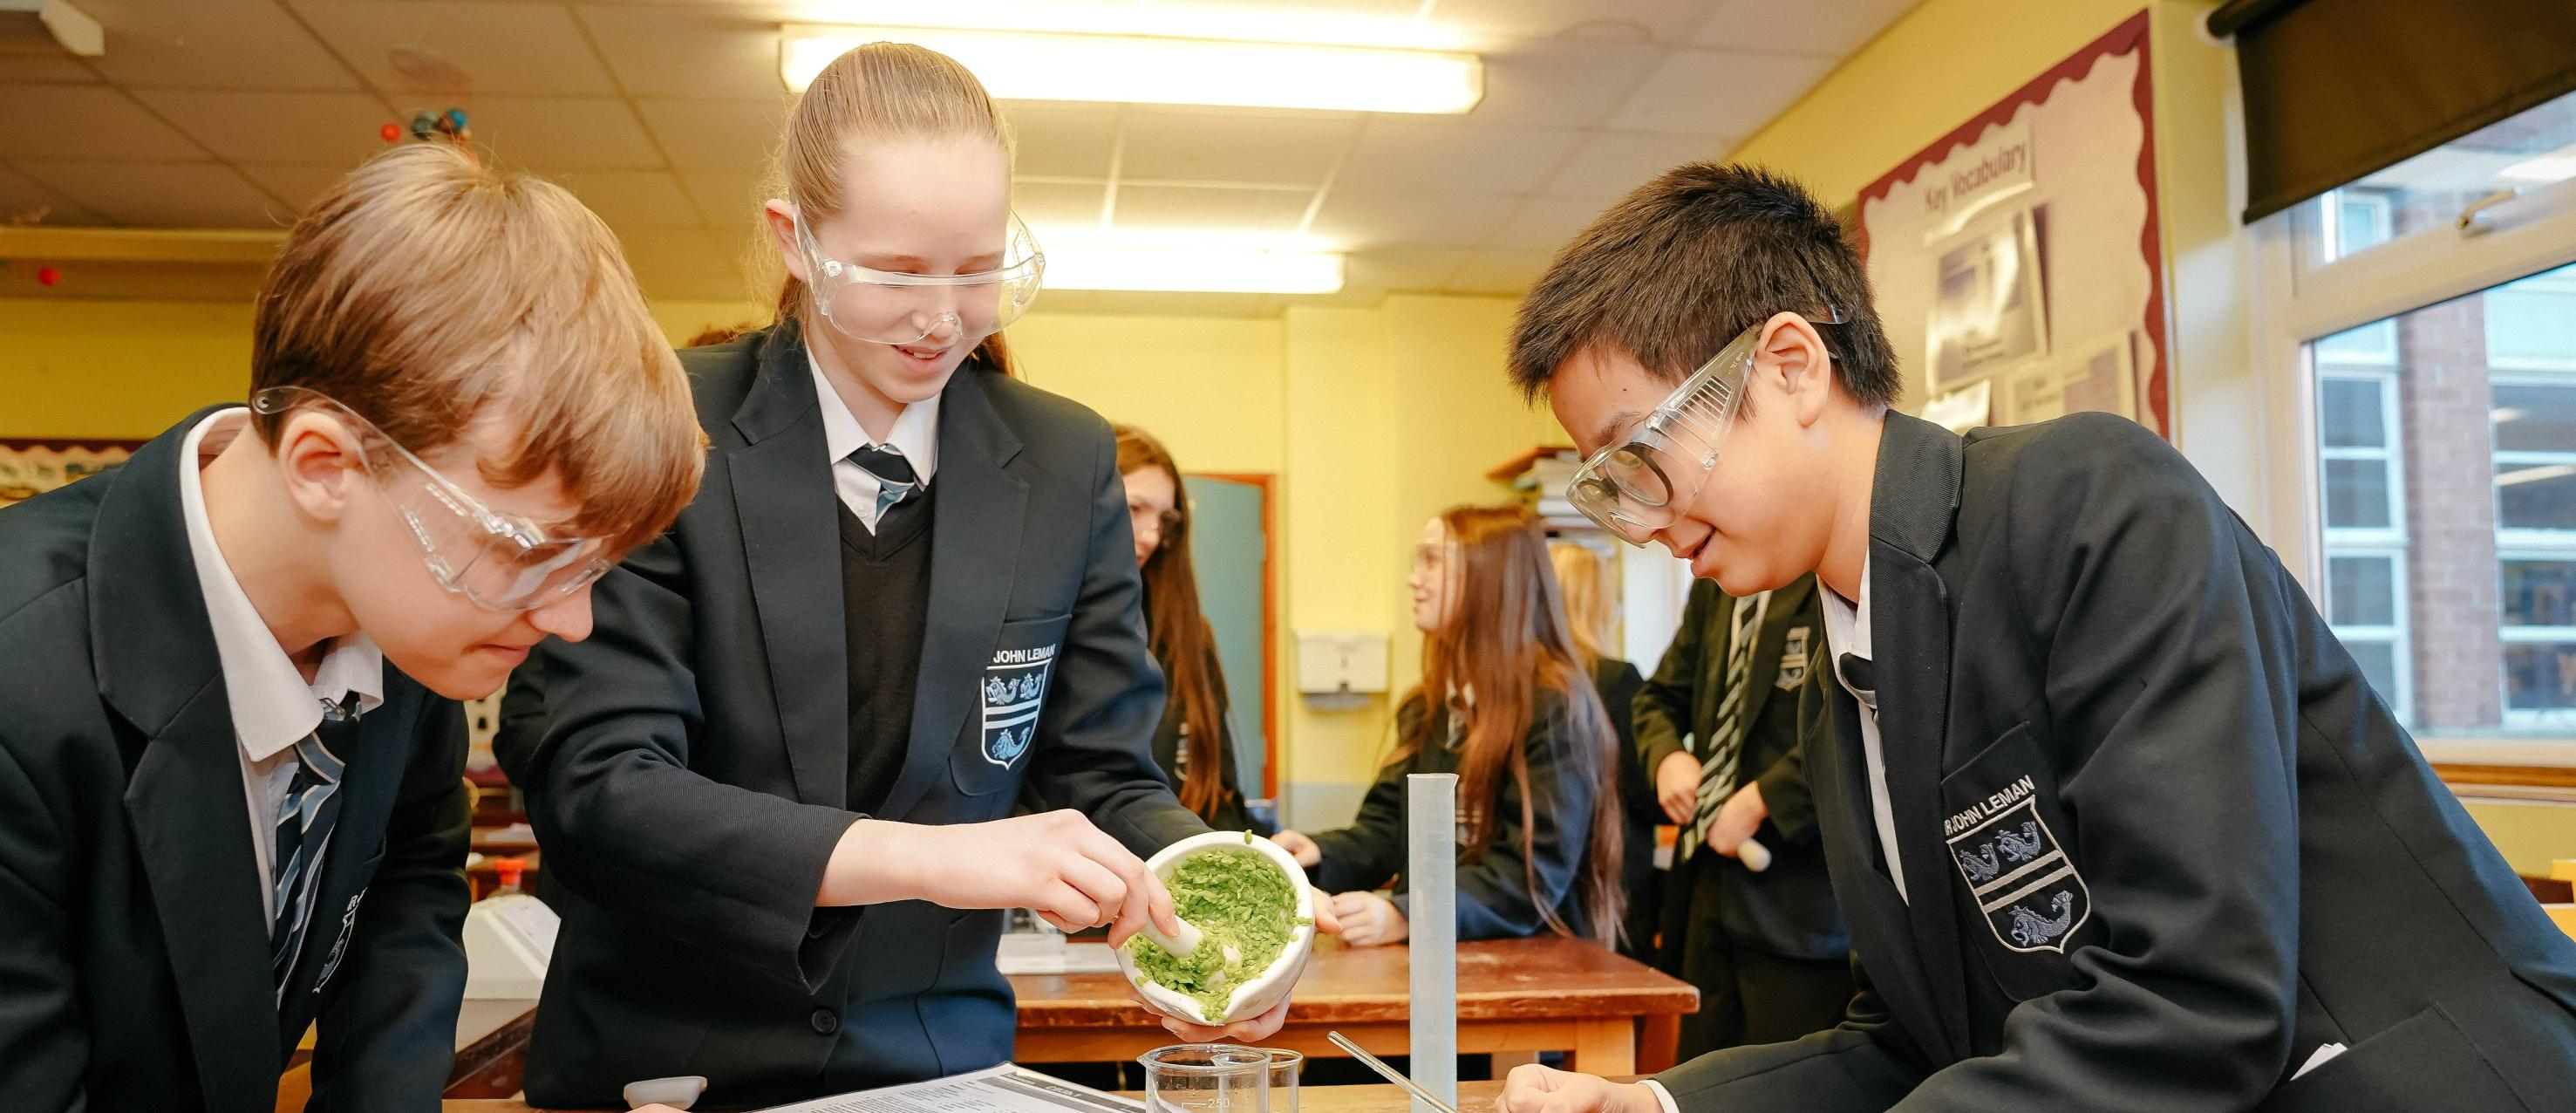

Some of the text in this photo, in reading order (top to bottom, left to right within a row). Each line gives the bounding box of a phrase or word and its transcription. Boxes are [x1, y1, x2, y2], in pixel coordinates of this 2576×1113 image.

[1925, 145, 2026, 215] Key Vocabulary
[993, 649, 1026, 664] JOHN
[1950, 805, 1983, 832] JOHN
[1979, 775, 2035, 816] LEMAN
[1208, 1097, 1230, 1109] 250
